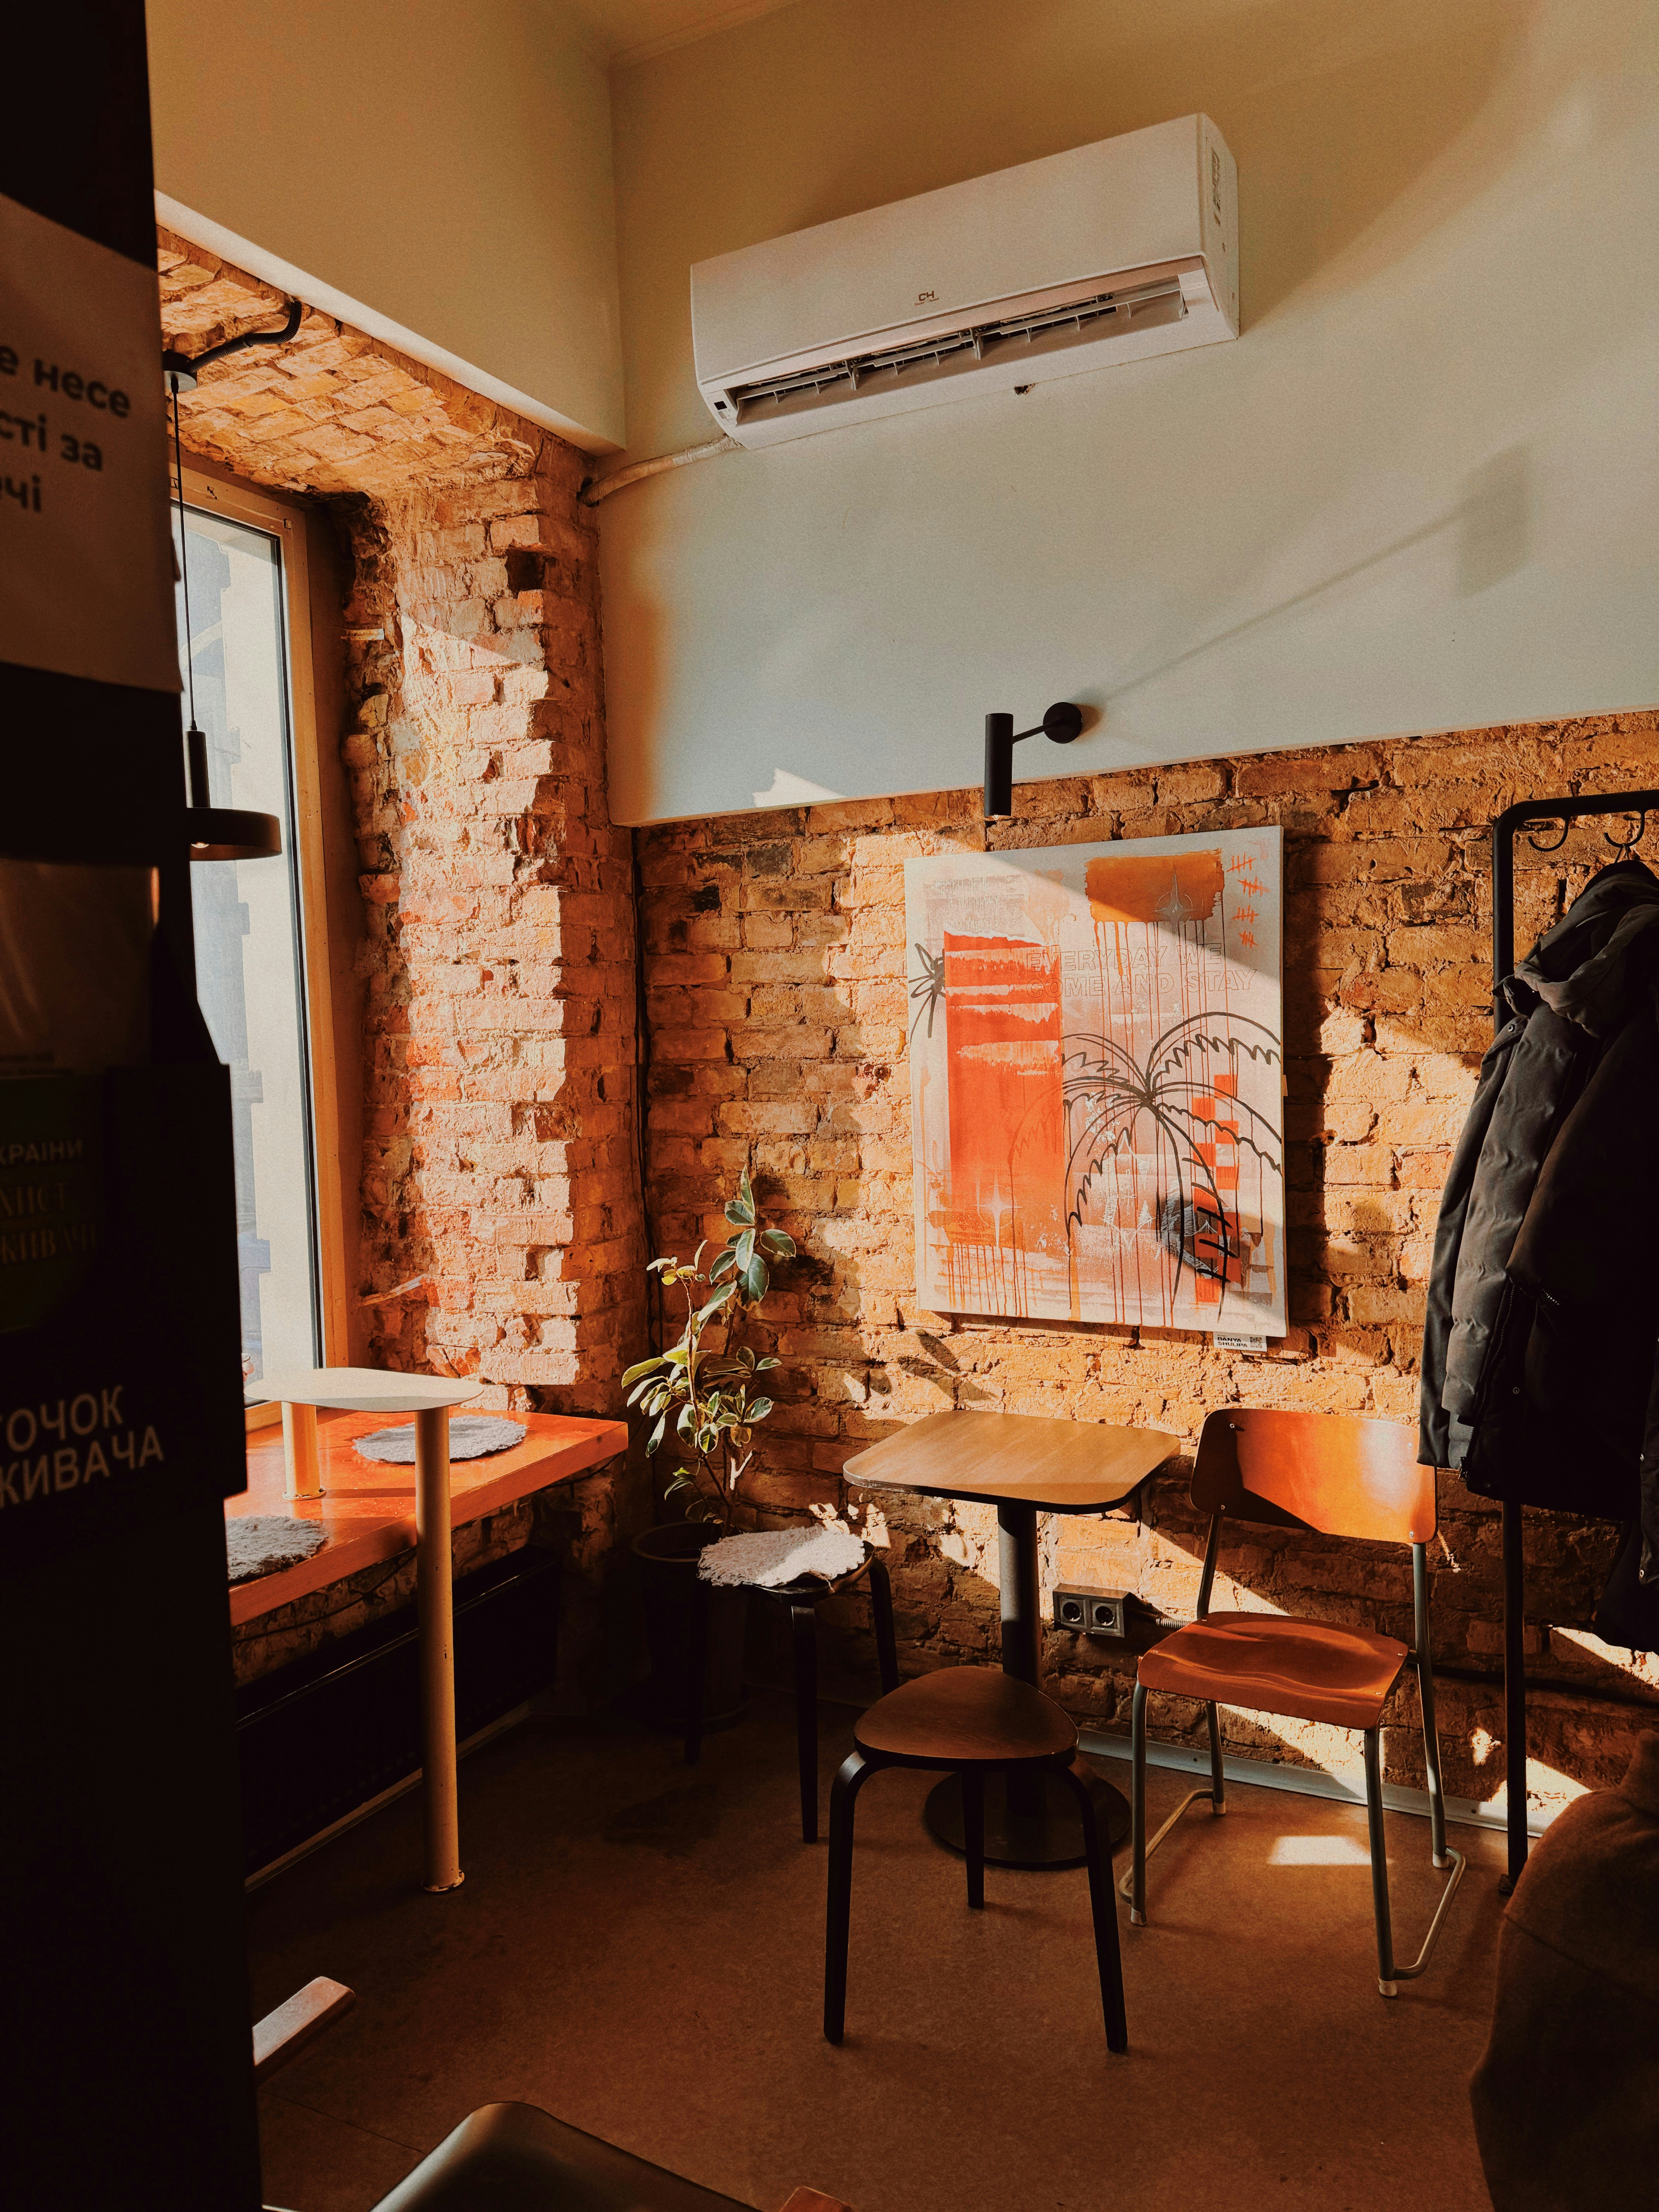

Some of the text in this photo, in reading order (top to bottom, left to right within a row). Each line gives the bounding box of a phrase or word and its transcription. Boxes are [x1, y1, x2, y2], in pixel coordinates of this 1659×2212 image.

[34, 359, 131, 418] несе
[61, 434, 102, 472] за
[0, 475, 41, 513] чі
[1027, 943, 1221, 972] EVERYDAY WE
[1026, 969, 1257, 998] COME AND STAY
[0, 1385, 122, 1451] ОЧОК
